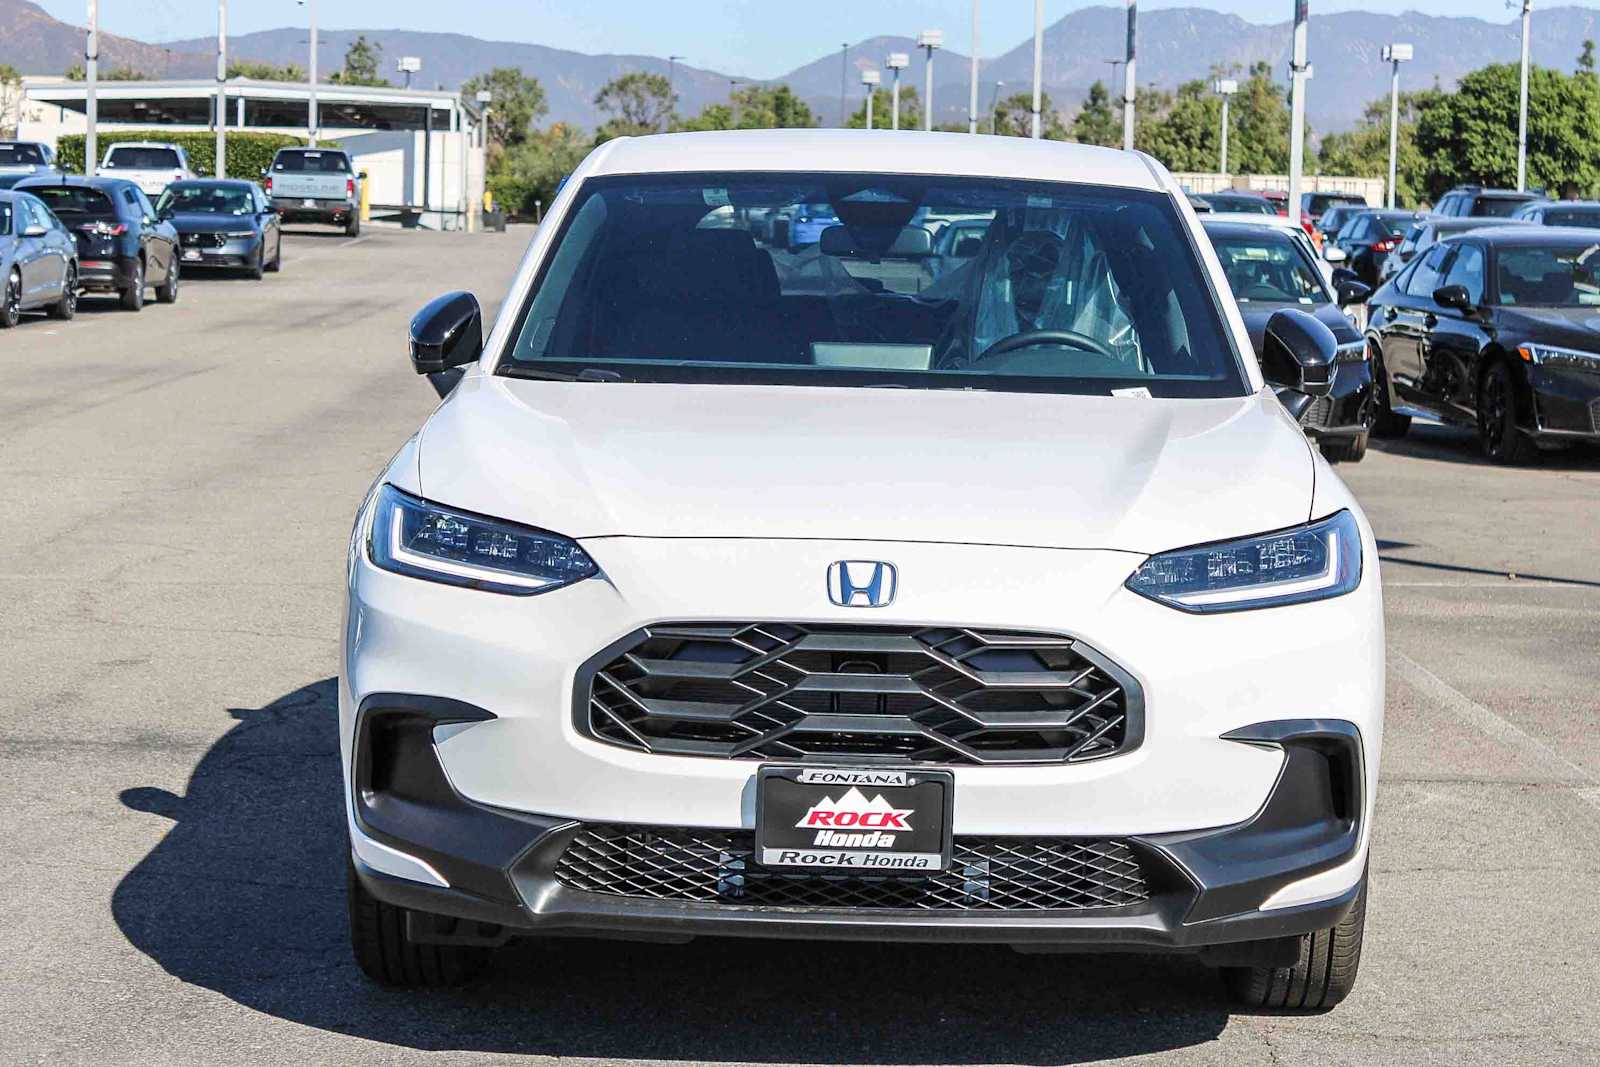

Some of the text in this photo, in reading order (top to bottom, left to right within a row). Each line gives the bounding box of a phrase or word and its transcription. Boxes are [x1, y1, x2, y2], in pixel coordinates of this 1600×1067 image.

[808, 772, 903, 784] FONTANA
[806, 810, 905, 827] ROCK
[813, 830, 896, 848] Honda
[778, 851, 929, 868] Rock Honda
